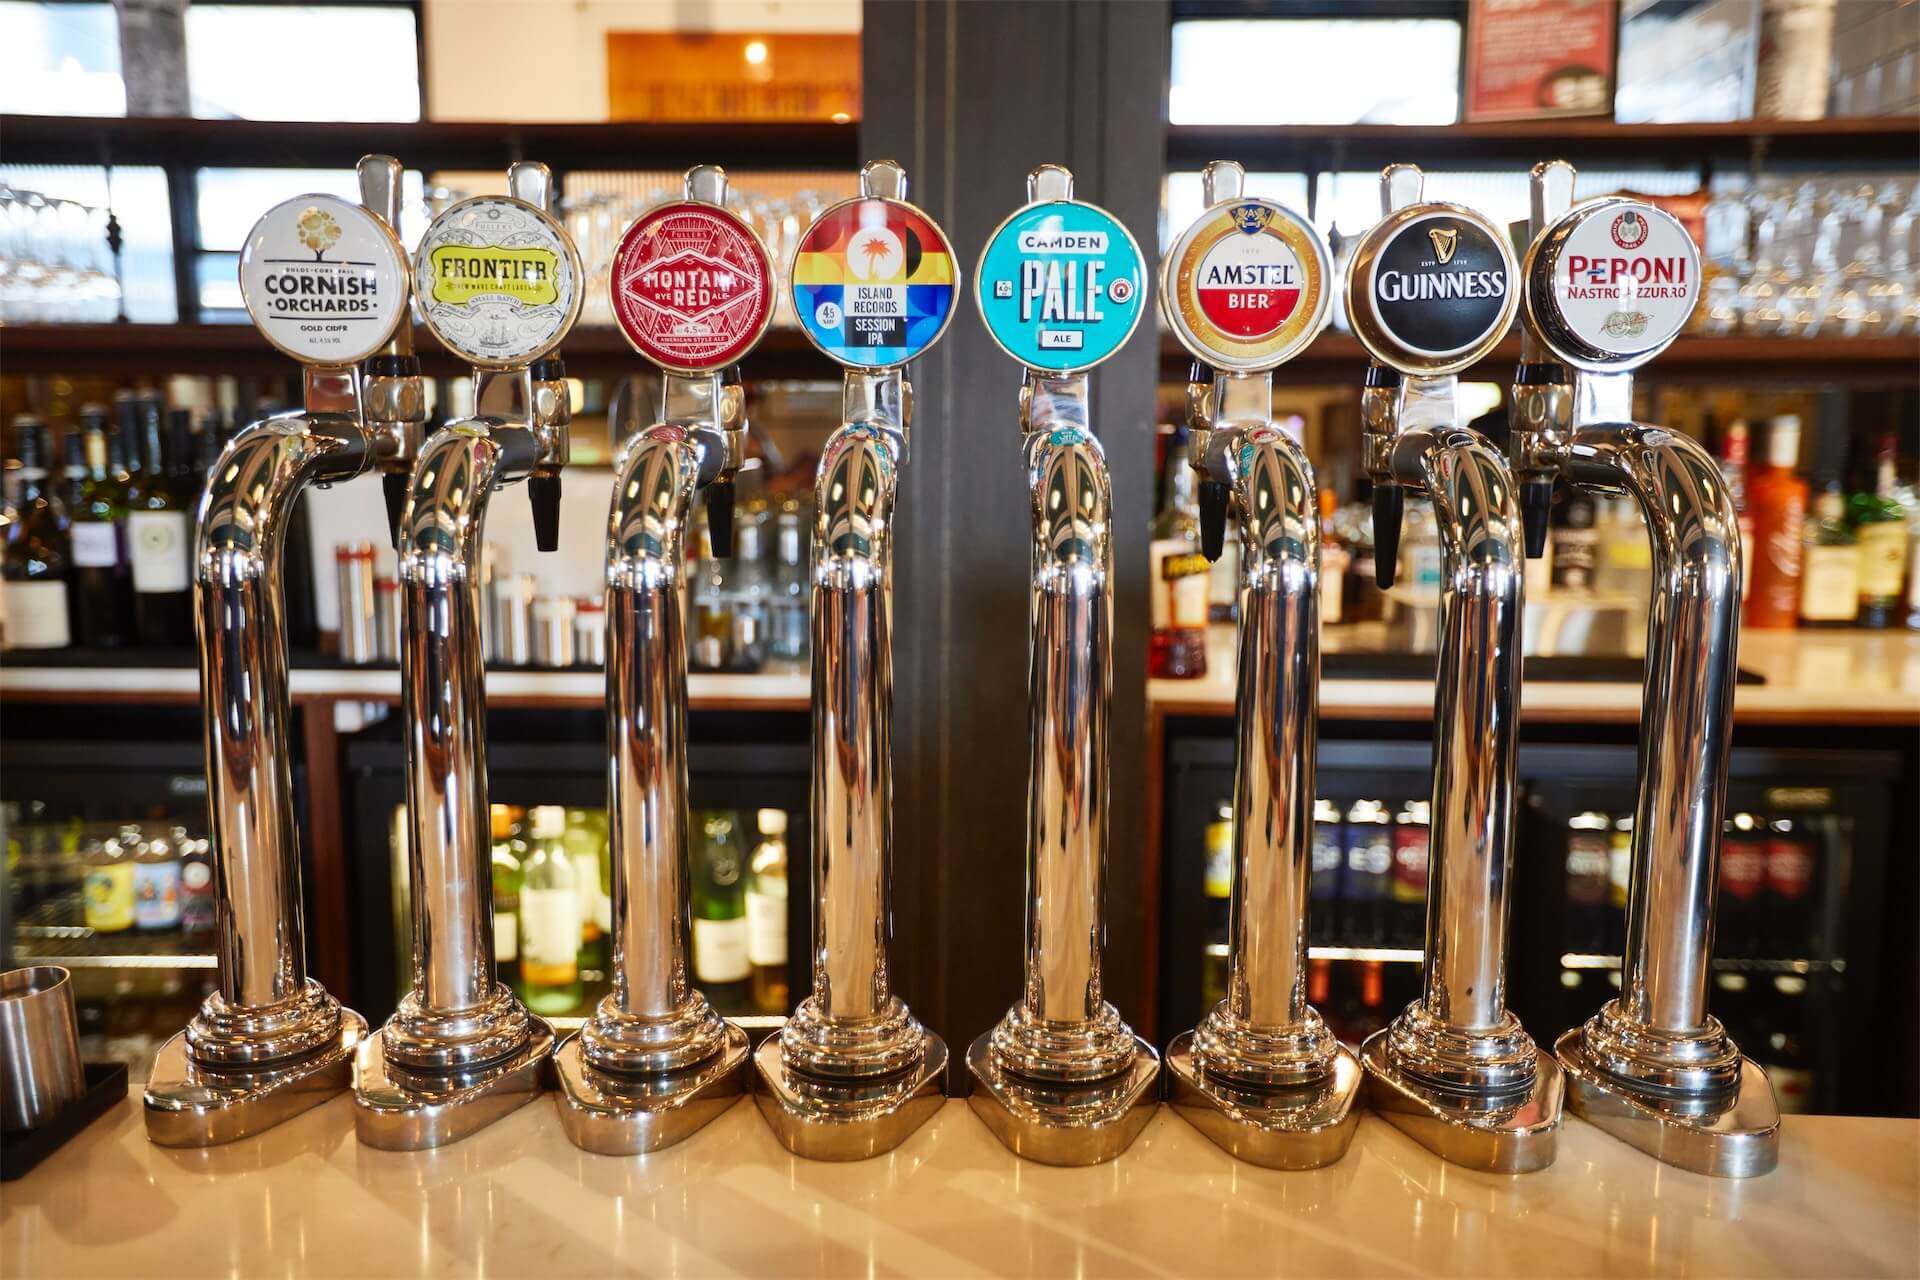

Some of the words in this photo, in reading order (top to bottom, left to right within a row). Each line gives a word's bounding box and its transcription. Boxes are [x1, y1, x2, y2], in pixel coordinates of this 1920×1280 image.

[1025, 236, 1100, 249] CAMDEN
[441, 258, 547, 280] FRONTIER
[1207, 265, 1293, 285] AMSTEL
[1568, 255, 1686, 285] PERONI
[265, 274, 377, 295] CORNISH
[646, 271, 737, 289] MONTANA
[1378, 271, 1505, 301] GUINNESS
[674, 289, 711, 306] RED
[858, 287, 893, 300] ISLAND
[1020, 259, 1105, 323] PALE
[275, 298, 369, 312] ORCHARDS
[854, 301, 898, 313] RECORDS
[1228, 293, 1269, 309] BIER
[855, 318, 896, 331] SESSION
[868, 332, 884, 345] IPA
[1053, 335, 1071, 343] ALE
